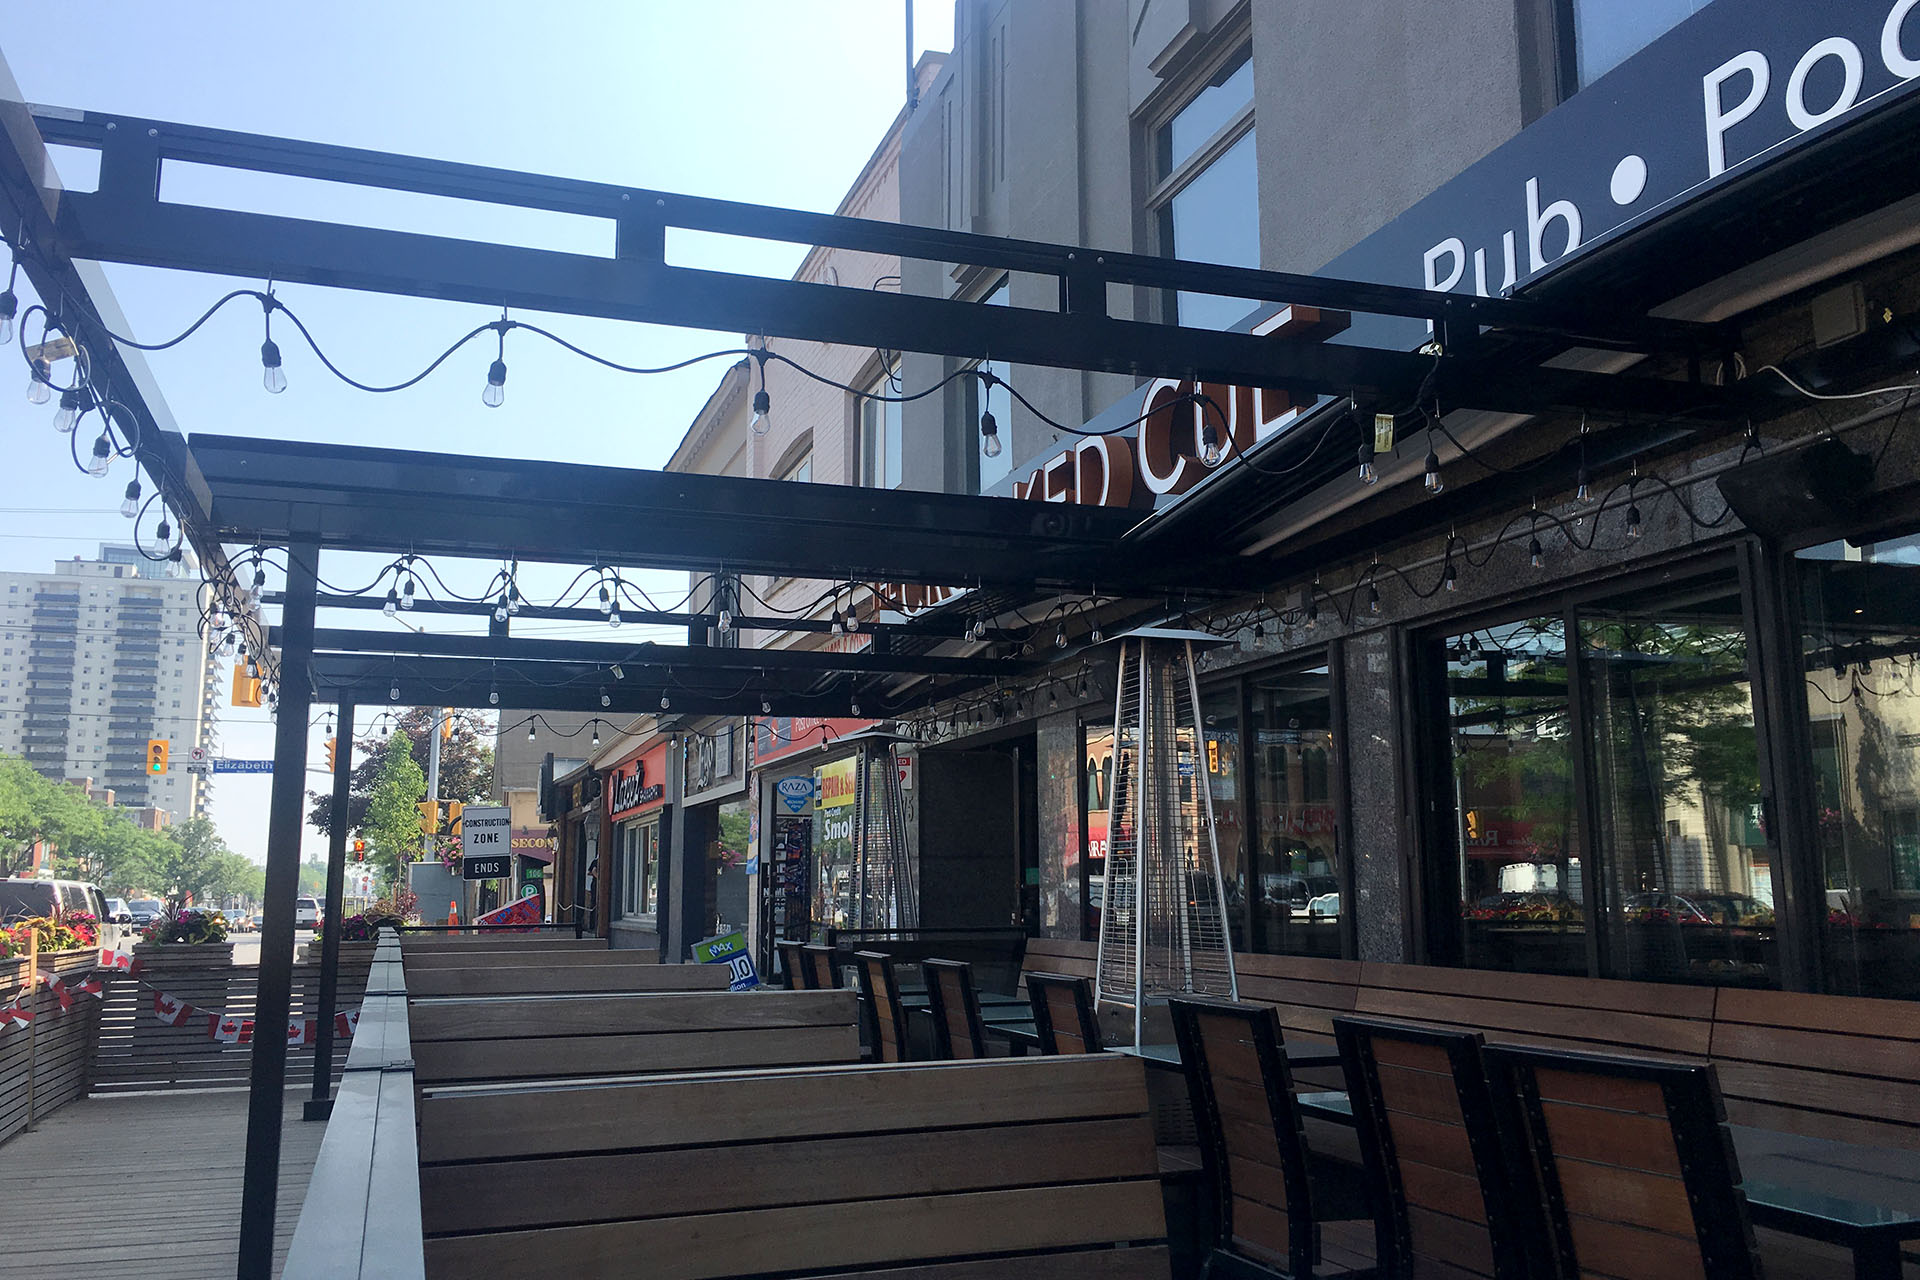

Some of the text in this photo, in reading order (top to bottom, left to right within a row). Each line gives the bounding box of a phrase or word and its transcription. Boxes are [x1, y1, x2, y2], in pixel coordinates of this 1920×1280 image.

[1423, 177, 1582, 332] Pub
[216, 760, 273, 769] Elizabeth
[782, 782, 808, 793] RAZA
[465, 818, 510, 828] CONSTRUCTION
[474, 833, 499, 843] ZONE
[474, 862, 499, 873] ENDS
[709, 941, 733, 957] MAX
